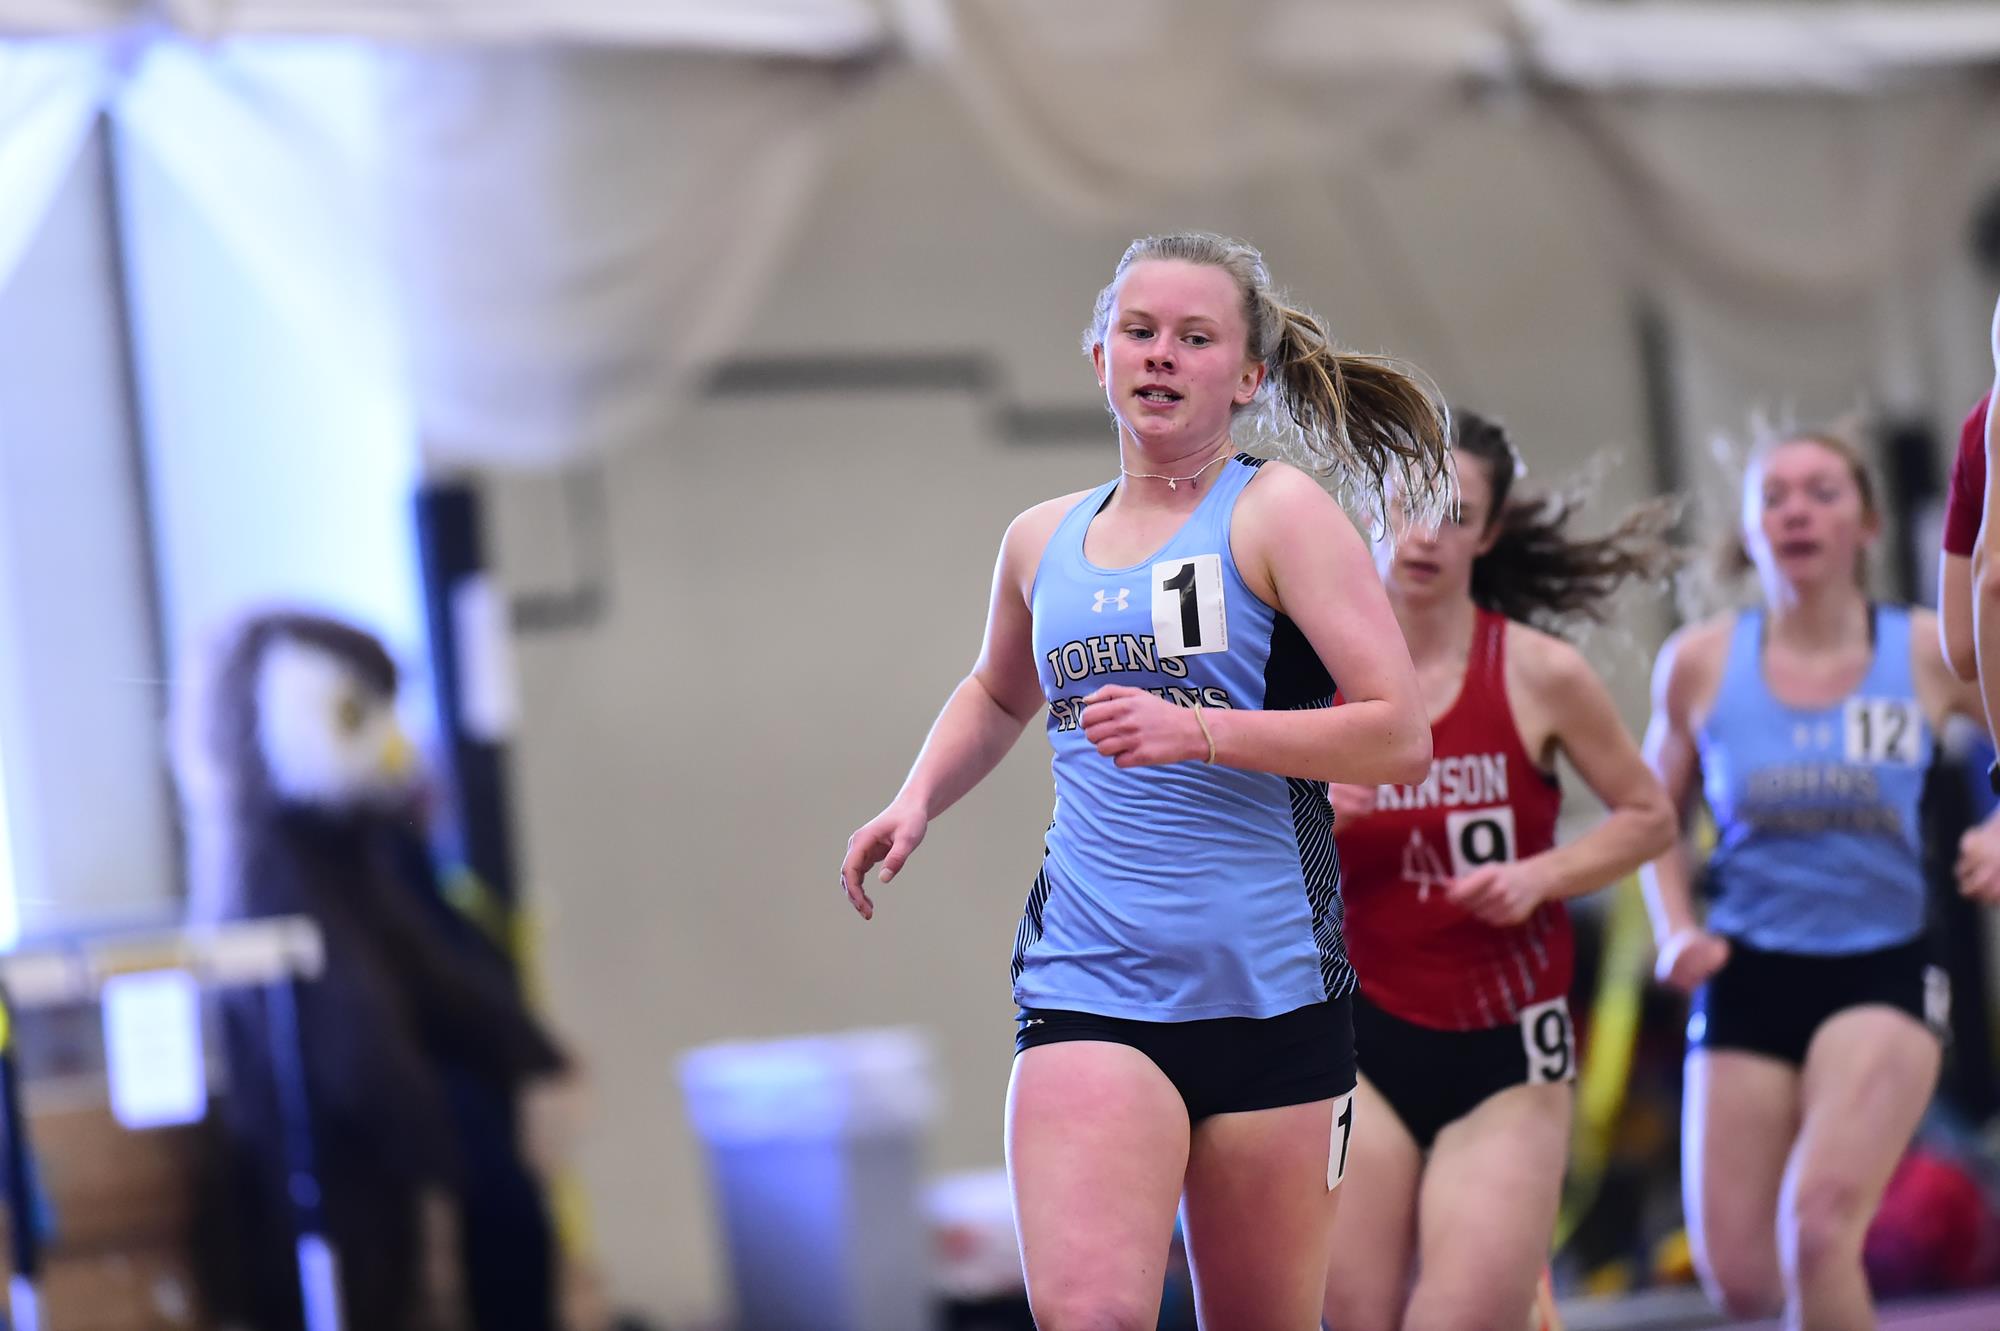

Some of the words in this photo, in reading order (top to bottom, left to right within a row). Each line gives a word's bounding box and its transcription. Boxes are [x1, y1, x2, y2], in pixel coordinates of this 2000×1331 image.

[1163, 563, 1201, 647] 1
[1047, 633, 1188, 689] JOHNS
[1857, 703, 1910, 762] 12
[1460, 819, 1507, 866] 9
[1534, 1009, 1568, 1080] 9
[1338, 1096, 1352, 1178] 1
